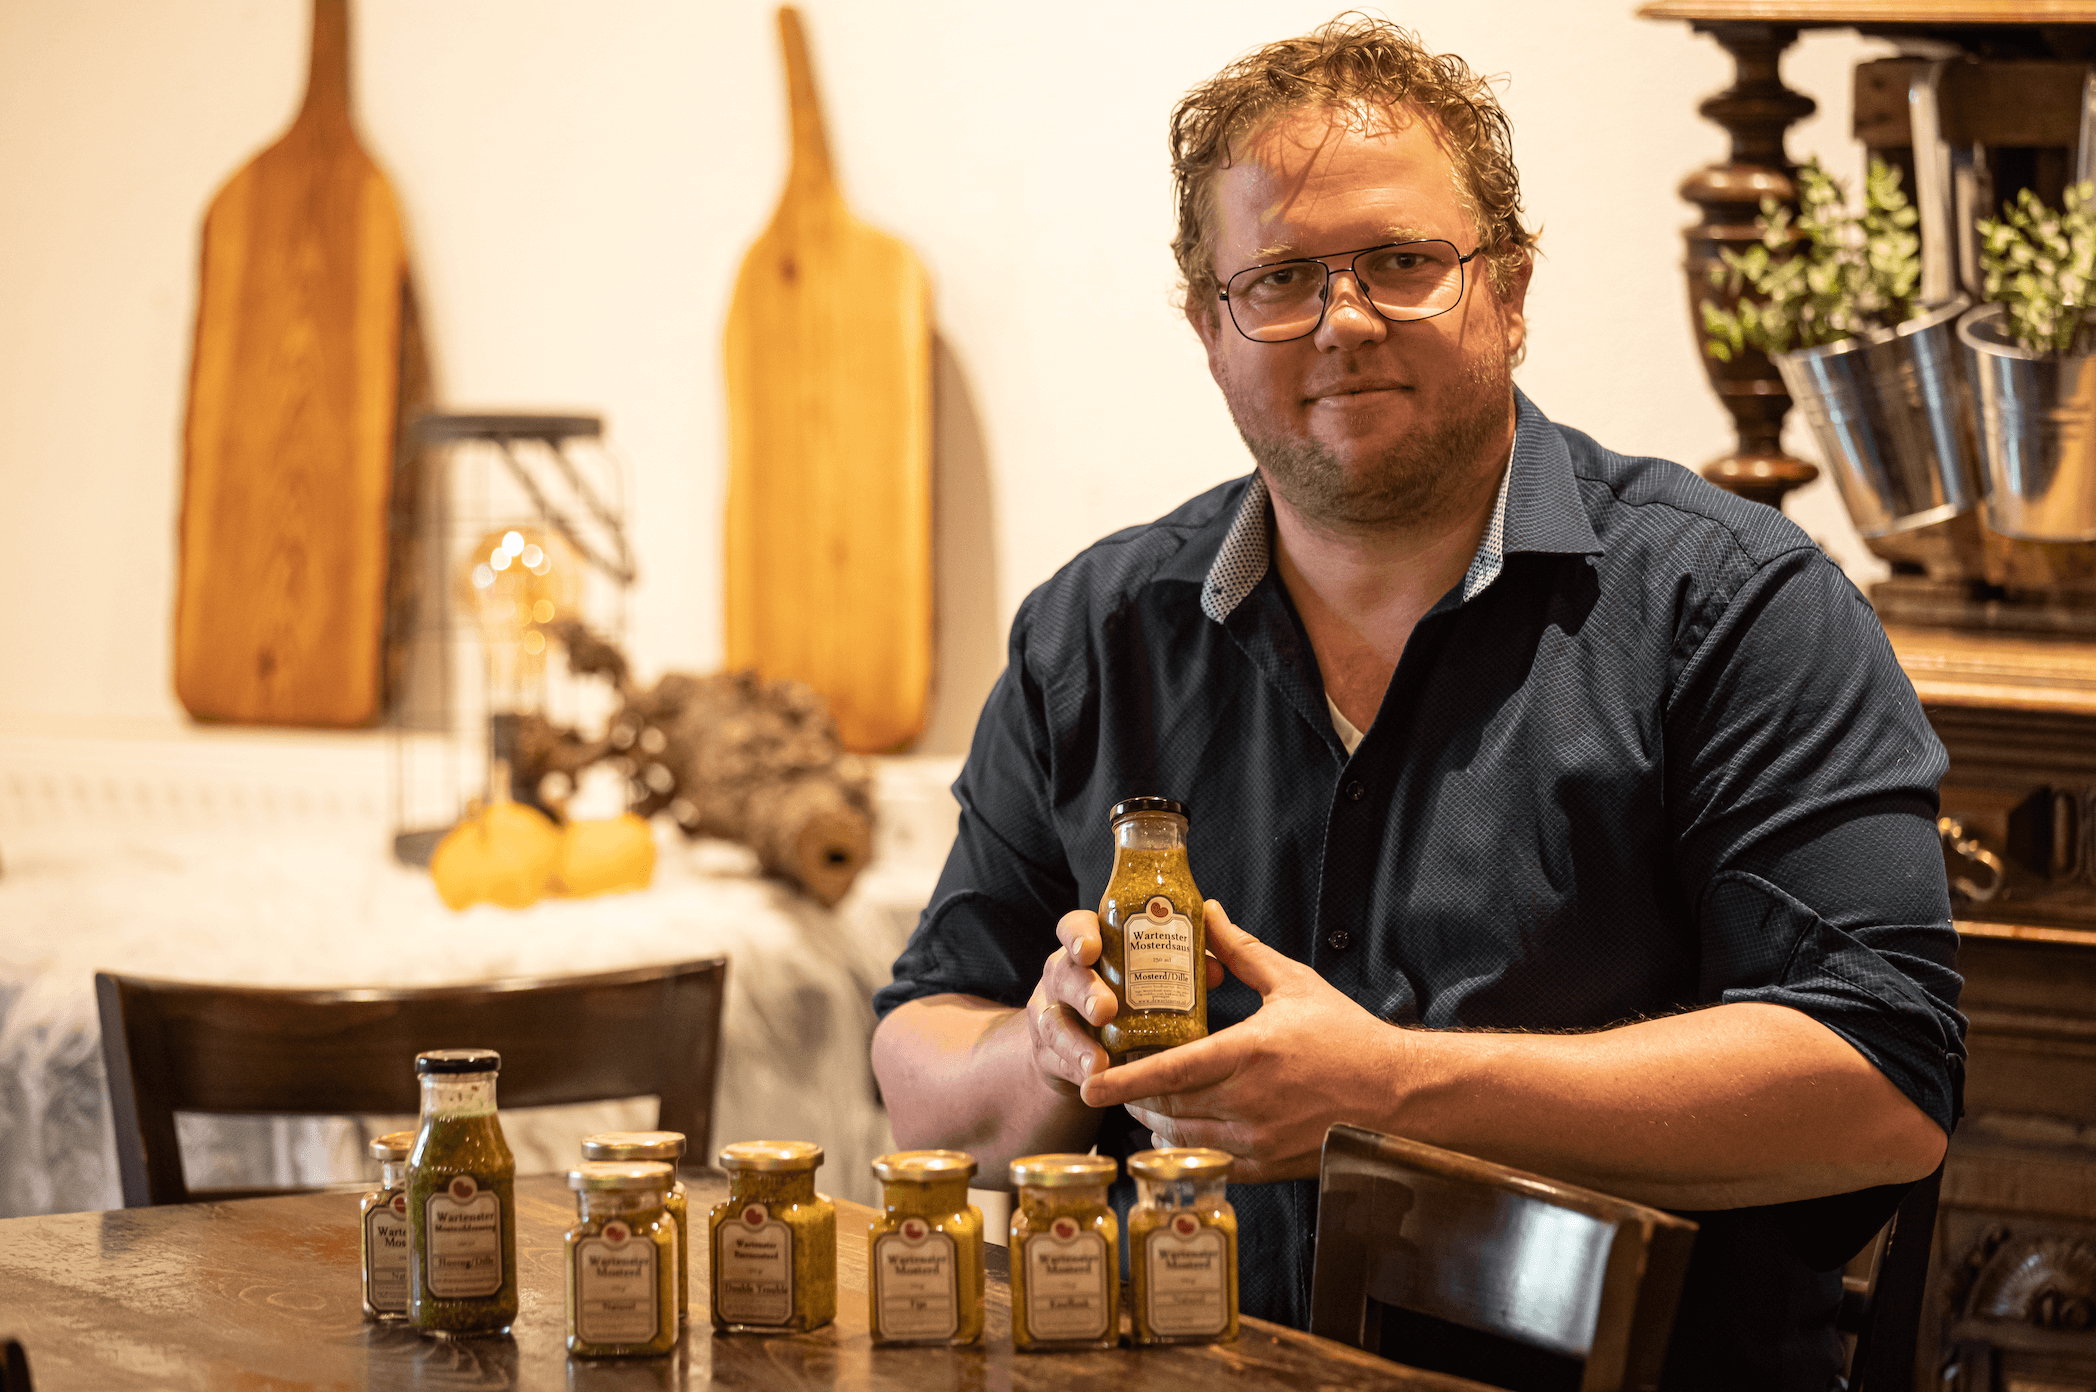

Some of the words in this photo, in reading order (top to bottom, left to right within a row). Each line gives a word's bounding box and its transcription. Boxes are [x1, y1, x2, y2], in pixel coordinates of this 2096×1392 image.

[1133, 931, 1188, 942] Wartenster
[1130, 941, 1190, 952] Mosterdsaus
[1134, 972, 1189, 982] Mosterd/Dille
[437, 1212, 495, 1222] Wartenster
